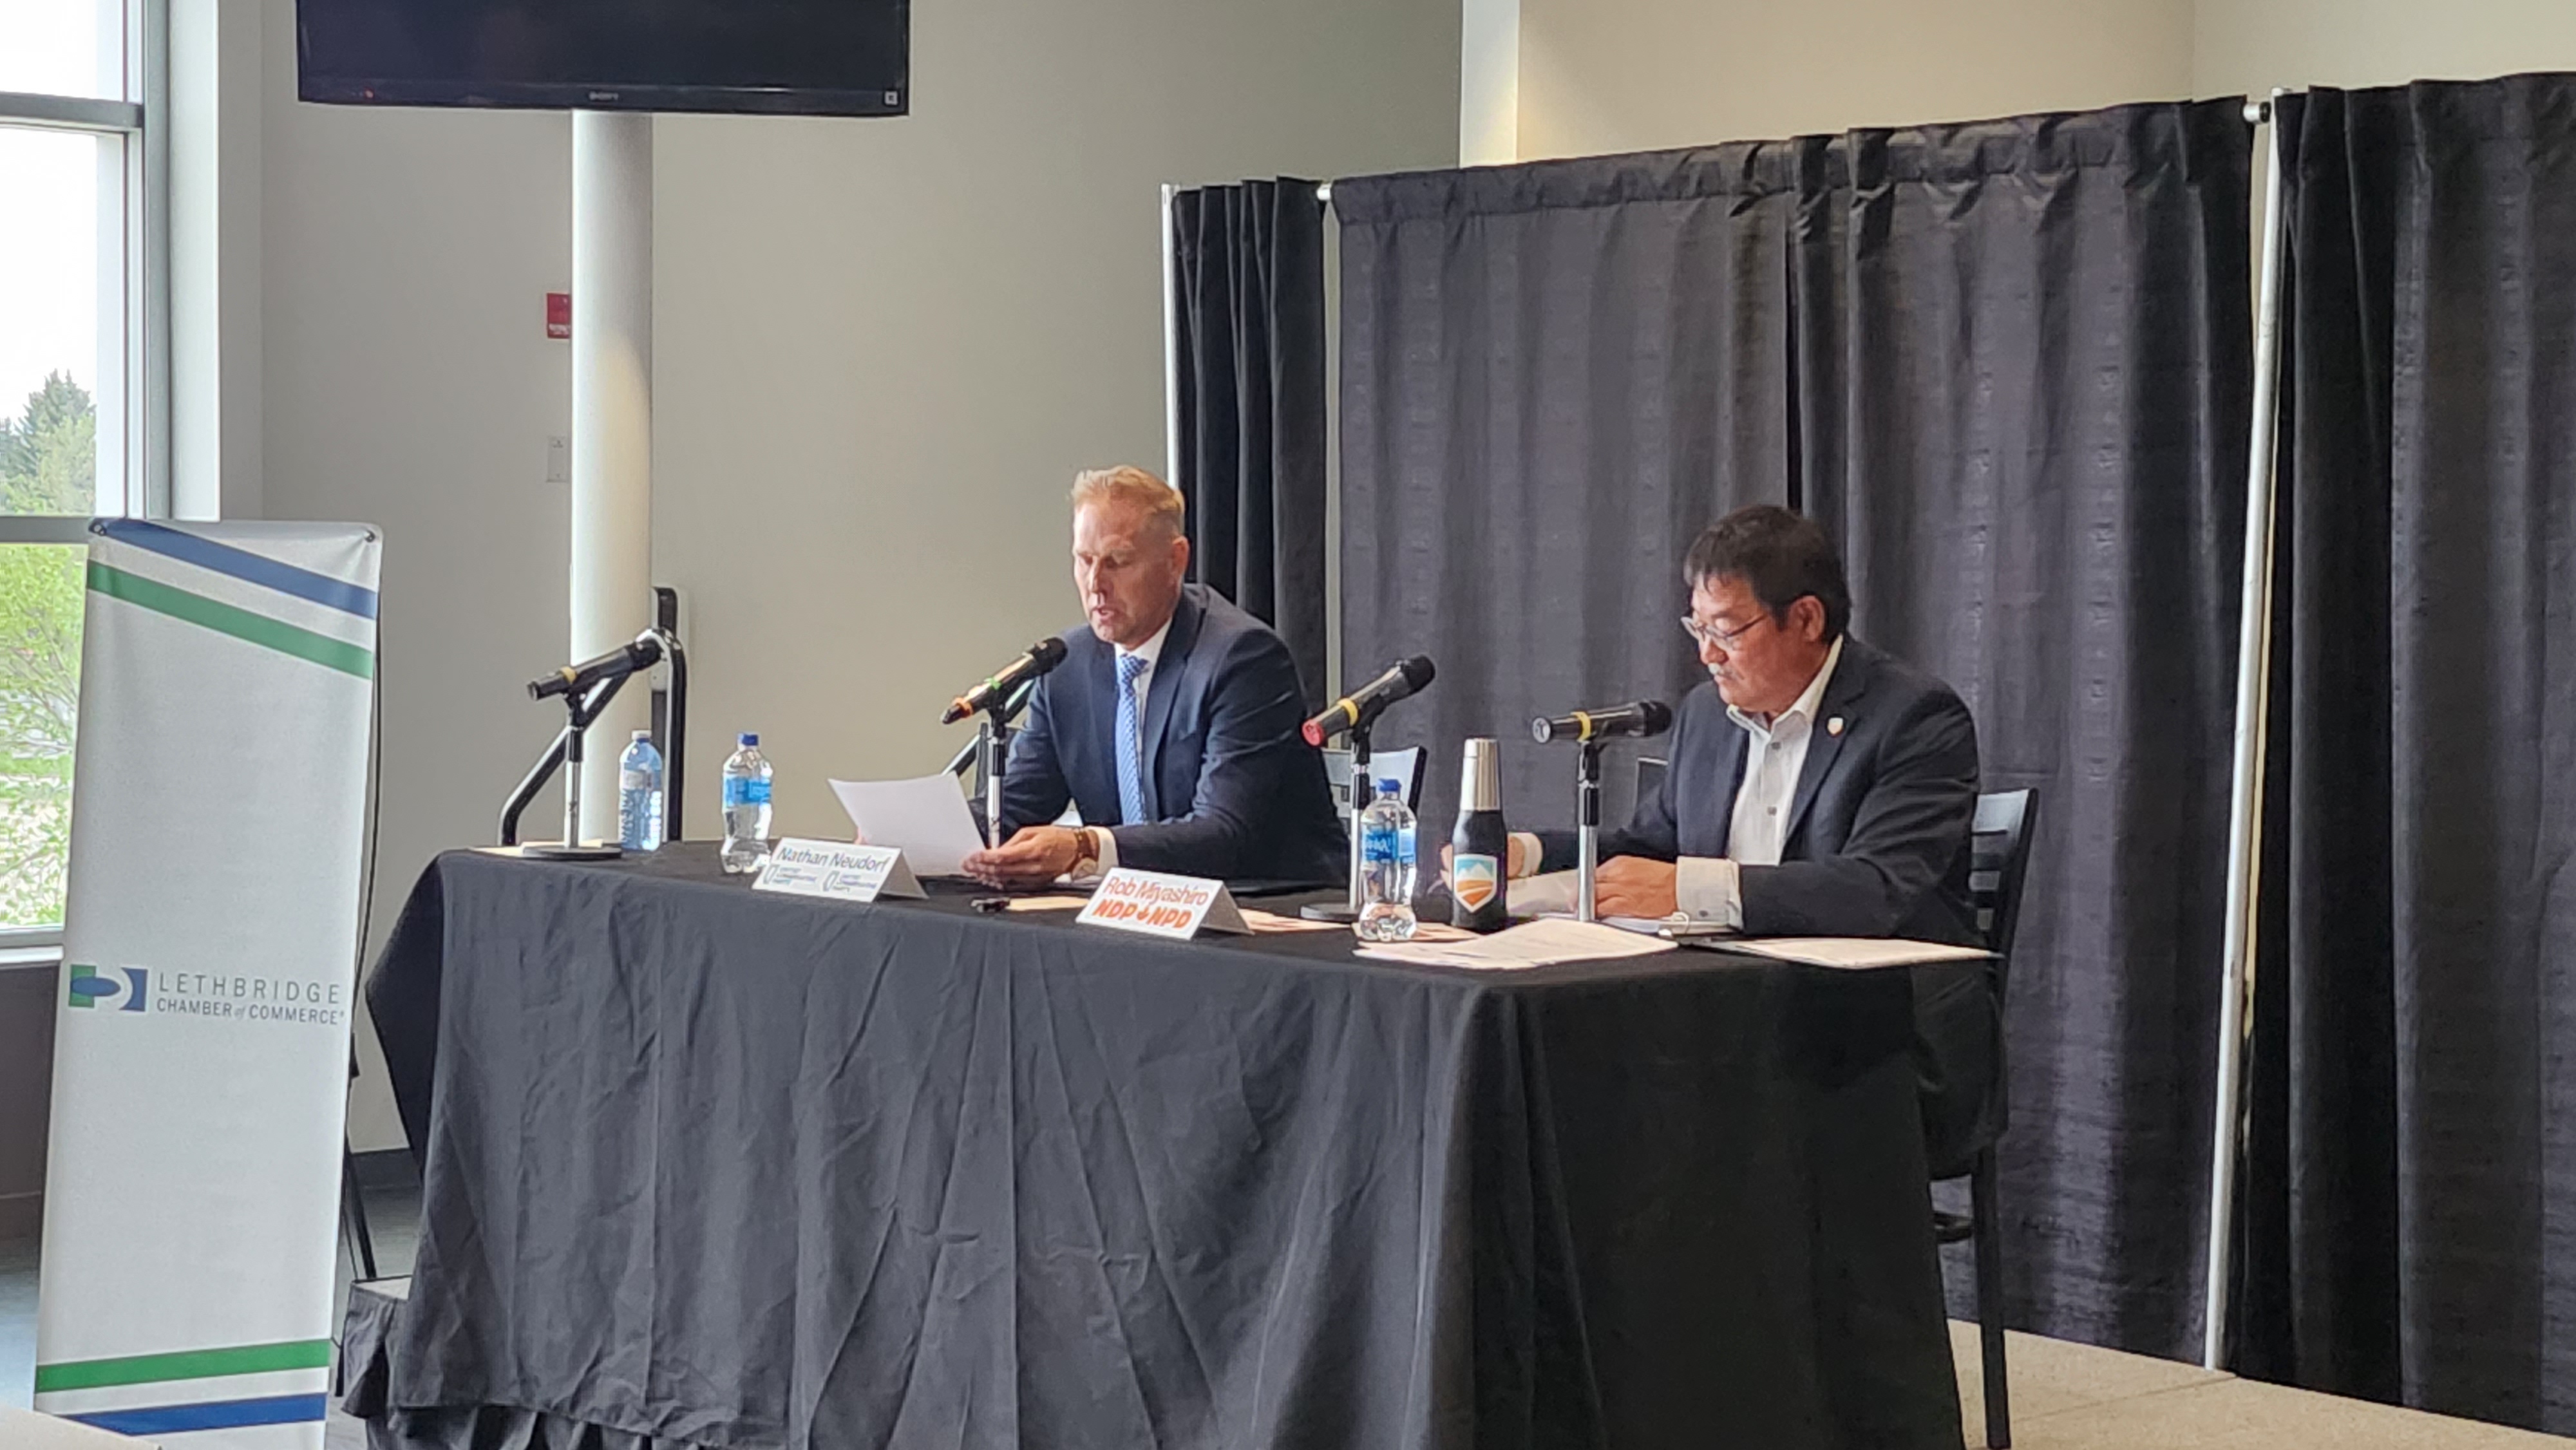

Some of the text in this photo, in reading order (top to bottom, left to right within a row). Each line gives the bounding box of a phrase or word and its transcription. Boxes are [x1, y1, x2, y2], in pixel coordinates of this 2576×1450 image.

[777, 847, 892, 872] Nathan Neudorf
[1103, 876, 1209, 907] Rob Miyashiro
[1092, 899, 1193, 929] NDP NPD
[158, 972, 341, 1004] LETHBRIDGE
[156, 997, 232, 1017] CHAMBER
[234, 1005, 245, 1019] of
